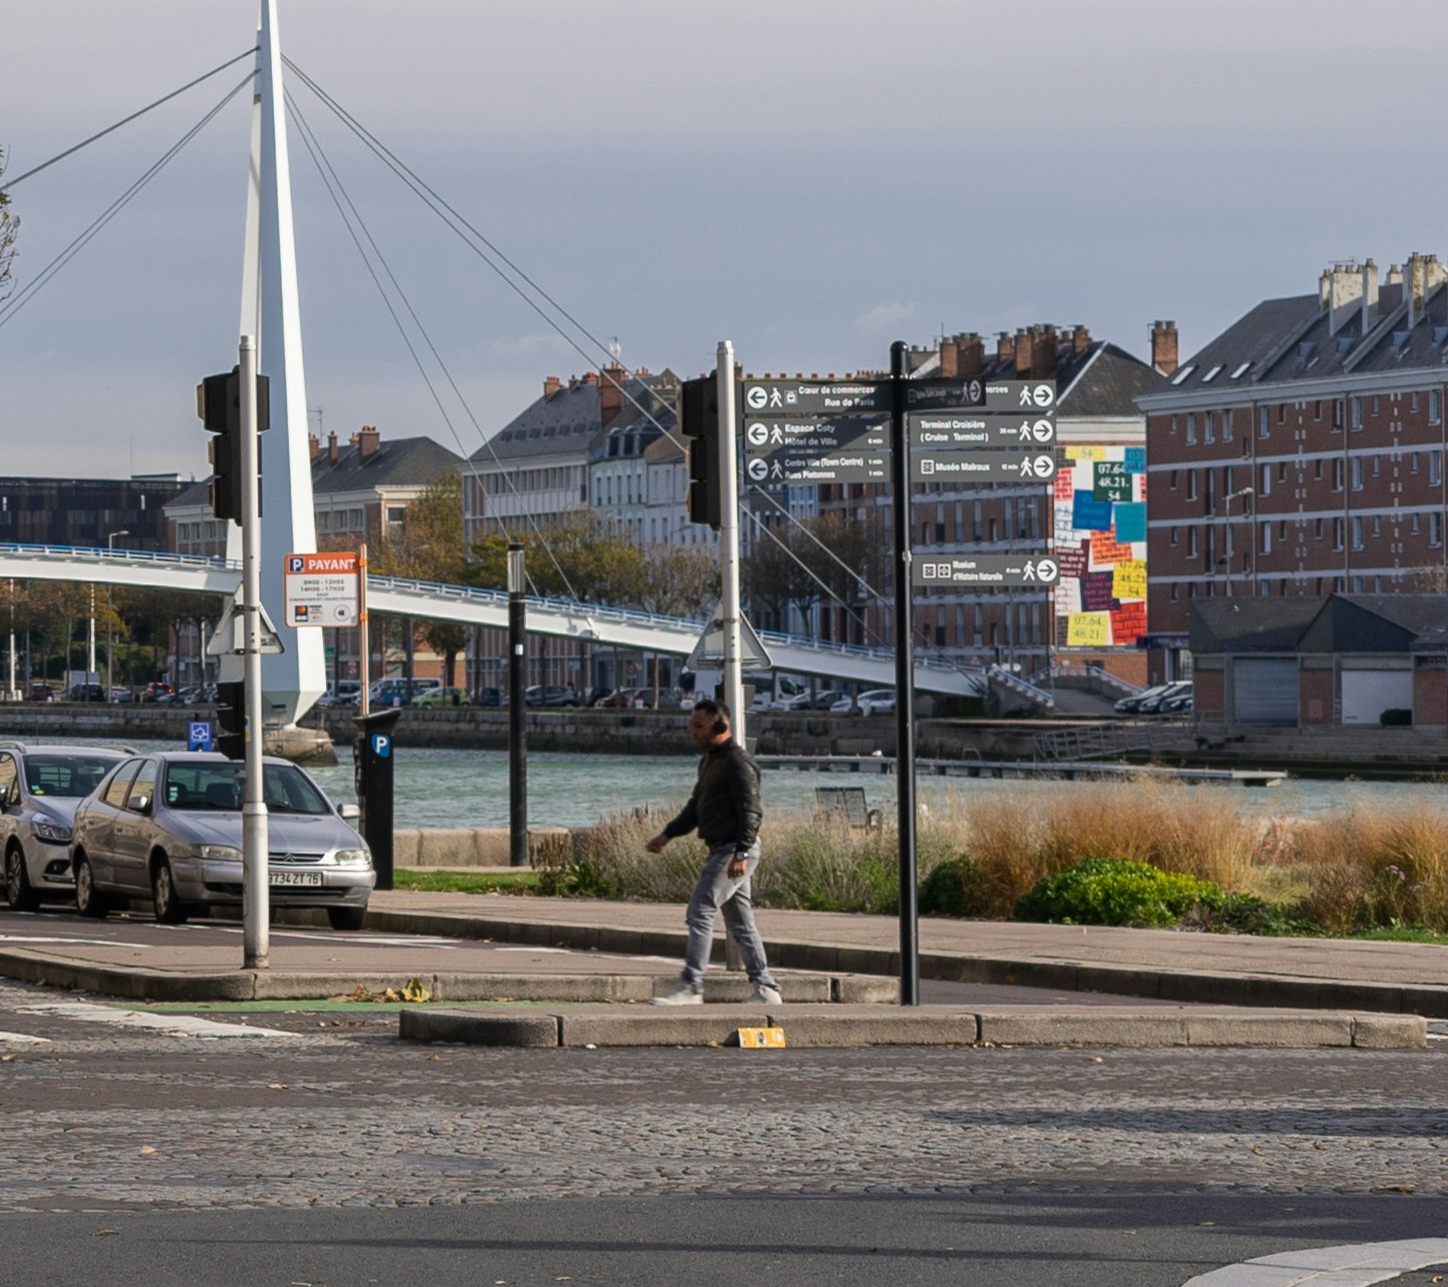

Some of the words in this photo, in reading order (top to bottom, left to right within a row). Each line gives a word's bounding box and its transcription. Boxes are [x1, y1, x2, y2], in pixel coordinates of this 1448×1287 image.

[820, 385, 831, 394] de
[831, 386, 875, 394] commerces
[985, 386, 1008, 394] erces
[824, 398, 841, 406] Rue
[842, 398, 853, 406] de
[854, 398, 875, 406] Paris
[785, 424, 815, 434] Espace
[816, 424, 835, 433] Coty
[921, 420, 952, 429] Terminal
[784, 437, 806, 445] Hôtel
[808, 437, 819, 445] de
[820, 437, 837, 445] Ville
[784, 459, 806, 467] Centre
[935, 462, 960, 471] Musée
[308, 559, 356, 570] PAYANT
[292, 873, 304, 884] ZT
[307, 873, 319, 884] 76
